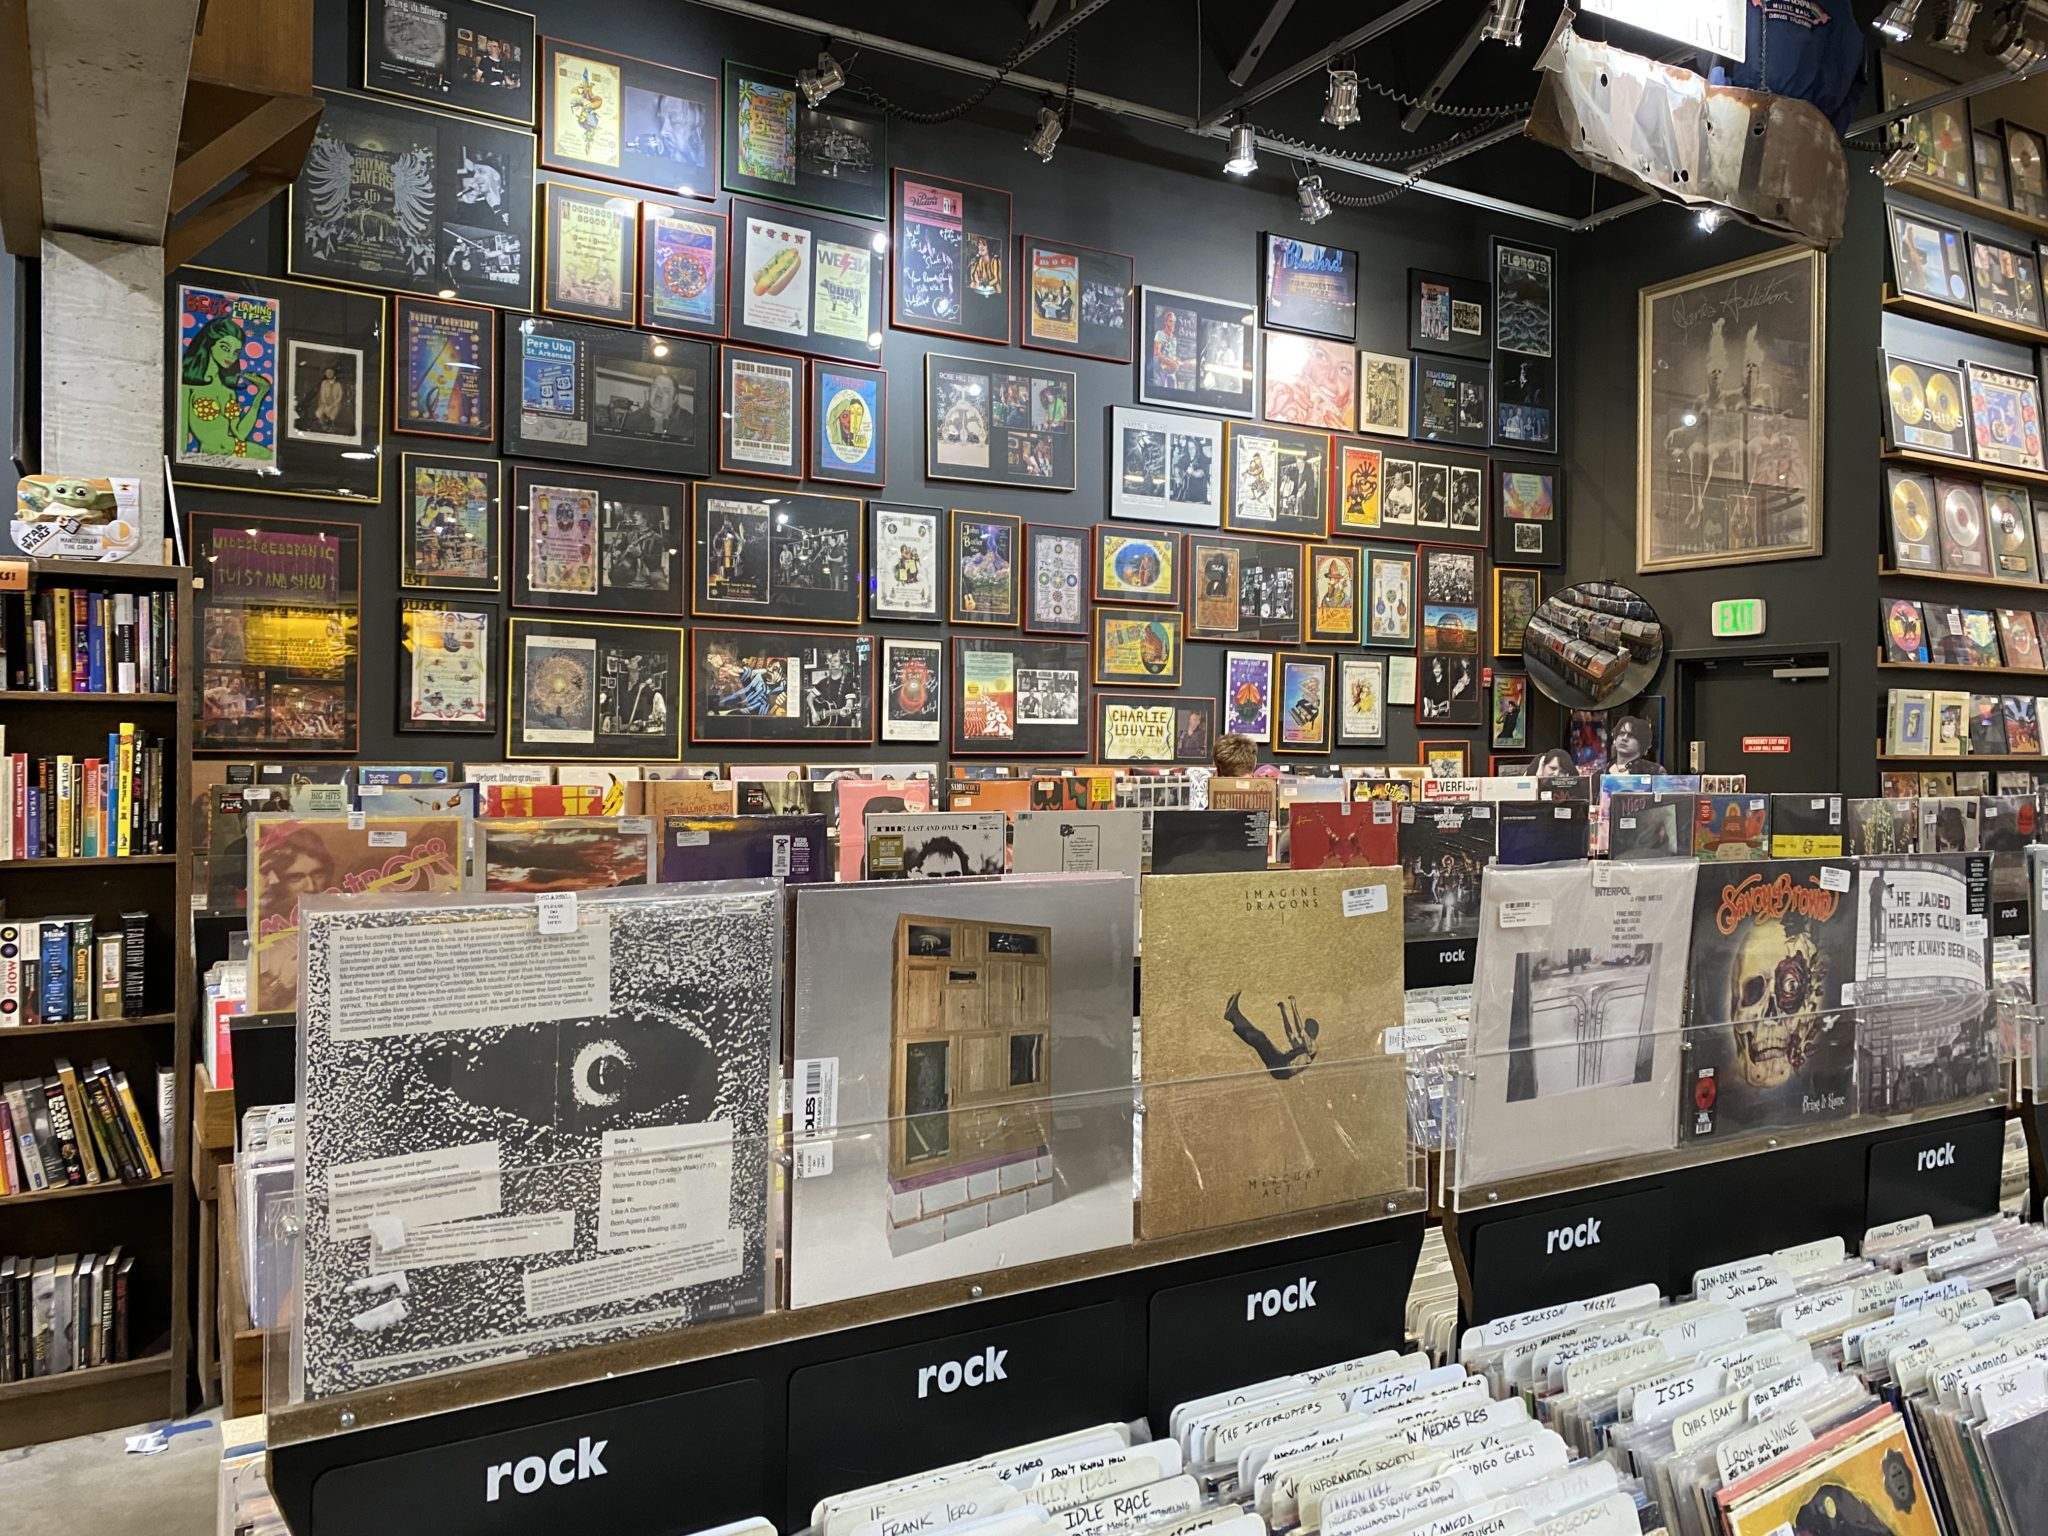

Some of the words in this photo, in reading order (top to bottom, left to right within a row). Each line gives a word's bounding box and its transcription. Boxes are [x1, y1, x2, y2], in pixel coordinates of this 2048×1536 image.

[1772, 3, 1793, 12] MUSIC
[354, 157, 391, 173] RHYME
[352, 170, 393, 191] SAYERS
[1040, 257, 1072, 267] moe.
[1501, 253, 1547, 273] FLOBOTS
[186, 295, 230, 315] BECK
[232, 301, 271, 316] FLAMING
[232, 311, 271, 323] LIPS
[526, 338, 550, 350] Pere
[552, 342, 571, 353] Ubu
[538, 349, 572, 360] Arkansas
[558, 379, 569, 388] 49
[1894, 401, 1919, 417] THE
[1924, 408, 1963, 428] SHINS
[22, 524, 47, 546] STAR
[25, 527, 51, 549] WARS
[1720, 601, 1755, 633] EXIT
[1112, 710, 1167, 723] CHARLIE
[1115, 725, 1163, 737] LOUVIN
[16, 762, 24, 773] The
[16, 788, 24, 803] Beach
[87, 771, 97, 808] SONGBOOKS
[311, 791, 323, 800] BIG
[326, 791, 341, 800] HITS
[16, 804, 24, 818] Boy
[677, 805, 706, 815] ROLLING
[708, 802, 730, 812] STONES
[1622, 797, 1646, 816] Nico
[1437, 820, 1462, 829] JACKET
[1245, 887, 1318, 899] IMAGINE
[1595, 887, 1631, 897] INTERPOL
[1246, 899, 1318, 911] DRAGONS
[1717, 873, 1778, 934] Savoy
[1772, 873, 1839, 922] Brown
[2001, 907, 2018, 919] rock
[1889, 913, 1931, 929] HEARTS
[1937, 915, 1961, 932] CLUB
[126, 928, 145, 967] FACTORY
[1439, 949, 1465, 962] rock
[1888, 941, 1915, 956] YOU'VE
[1918, 941, 1946, 956] ALWAYS
[1948, 942, 1966, 958] BEEN
[1967, 946, 1983, 968] HERE
[75, 948, 88, 983] Country
[8, 961, 17, 994] MOJO
[126, 971, 145, 997] MADE
[163, 1078, 173, 1104] JANIS
[1802, 1095, 1821, 1113] Bring
[1821, 1094, 1827, 1108] It
[1828, 1092, 1845, 1110] Home
[163, 1105, 173, 1125] IAN
[805, 1097, 815, 1137] IDLES
[614, 1159, 634, 1167] French
[1917, 1142, 1955, 1171] rock
[627, 1169, 651, 1177] Veranda
[1248, 1169, 1320, 1190] MERCURY
[613, 1181, 635, 1189] Women
[1263, 1184, 1291, 1197] ACT
[626, 1217, 642, 1225] Again
[647, 1226, 668, 1234] Beating
[1547, 1217, 1602, 1254] rock
[1247, 1277, 1317, 1321] rock
[1860, 1284, 1882, 1300] JAMES
[1884, 1279, 1903, 1294] GANG
[1494, 1320, 1516, 1336] JOE
[1522, 1306, 1568, 1326] JACKSON
[1682, 1322, 1697, 1340] IVY
[918, 1346, 1008, 1399] rock
[1734, 1364, 1754, 1382] JASON
[1655, 1378, 1694, 1401] ISIS
[1996, 1380, 2017, 1398] JADE
[1753, 1393, 1769, 1406] IRON
[1406, 1430, 1418, 1445] IN
[1422, 1417, 1461, 1443] MEDIAS
[1465, 1411, 1489, 1425] RES
[1682, 1417, 1707, 1437] CHRIS
[1710, 1401, 1738, 1424] ISAAK
[1505, 1445, 1535, 1463] GIRLS
[486, 1437, 609, 1502] rock
[1015, 1458, 1043, 1475] YARD
[1051, 1464, 1075, 1479] DON'T
[1080, 1459, 1104, 1471] KNOW
[1309, 1461, 1372, 1493] INFORMATION
[1376, 1451, 1416, 1472] SOCIETY
[871, 1506, 886, 1521] IF
[1064, 1501, 1104, 1530] IDLE
[1114, 1490, 1151, 1516] RACE
[882, 1514, 934, 1536] FRANK
